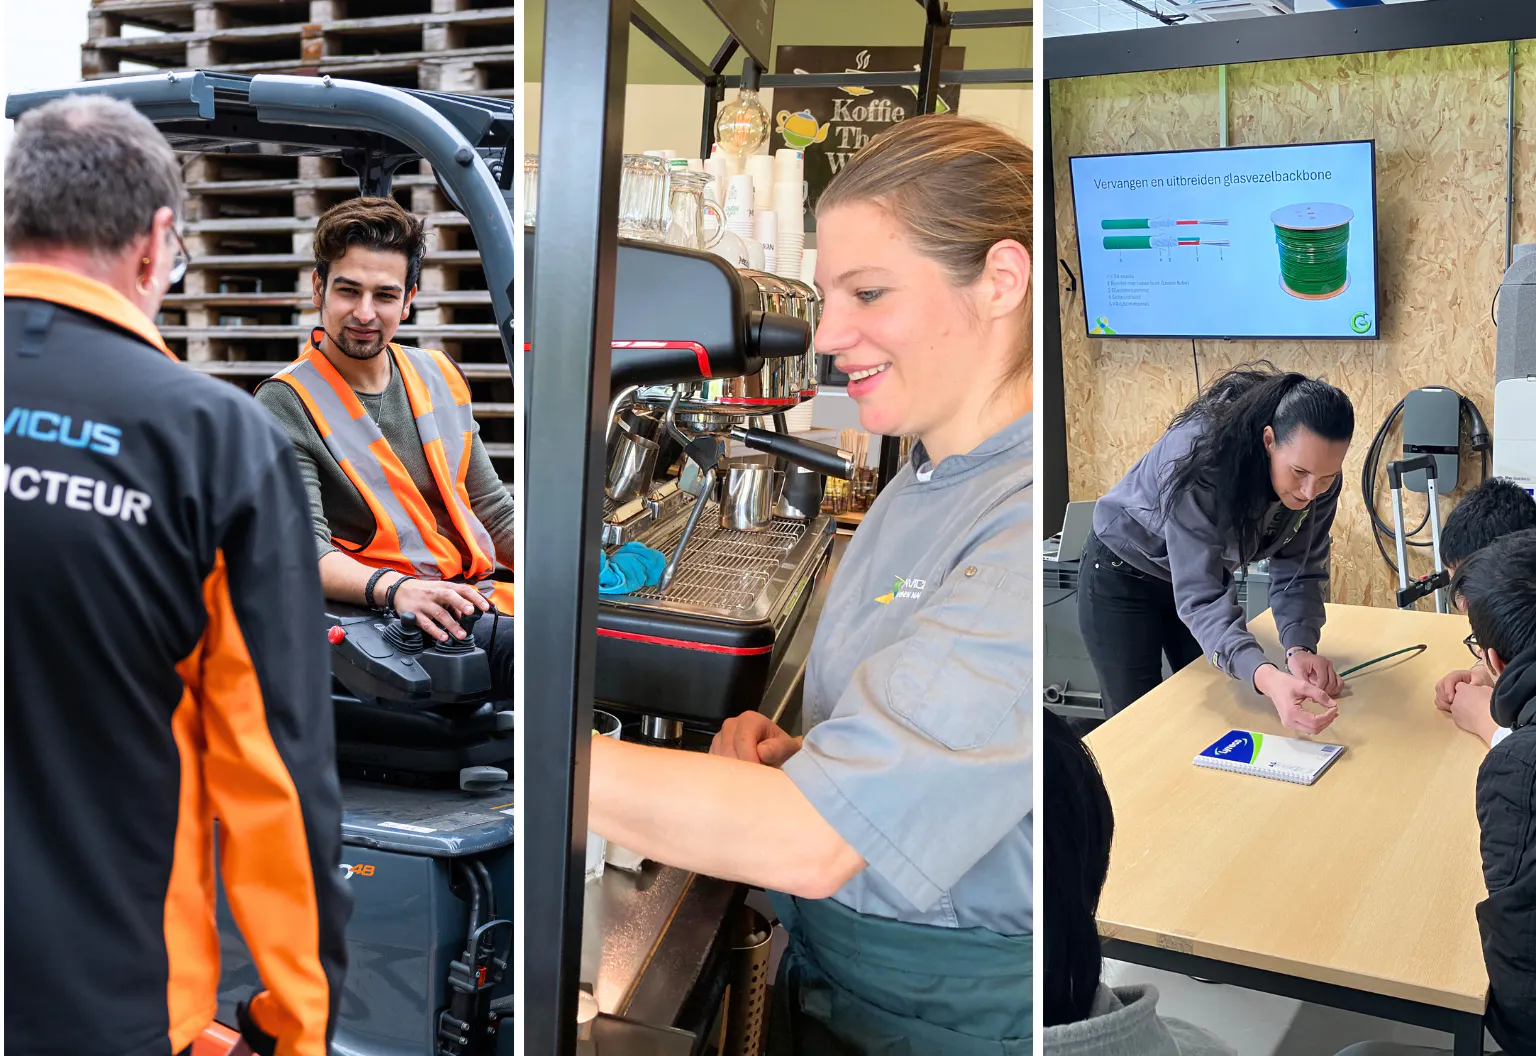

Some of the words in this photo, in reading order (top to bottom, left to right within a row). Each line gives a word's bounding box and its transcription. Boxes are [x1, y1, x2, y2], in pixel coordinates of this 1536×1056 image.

[830, 98, 906, 123] Koffie
[1093, 178, 1149, 190] Vervangen
[1150, 178, 1165, 188] en
[1166, 173, 1221, 187] uitbreiden
[1223, 169, 1333, 187] glasvezelbackbone
